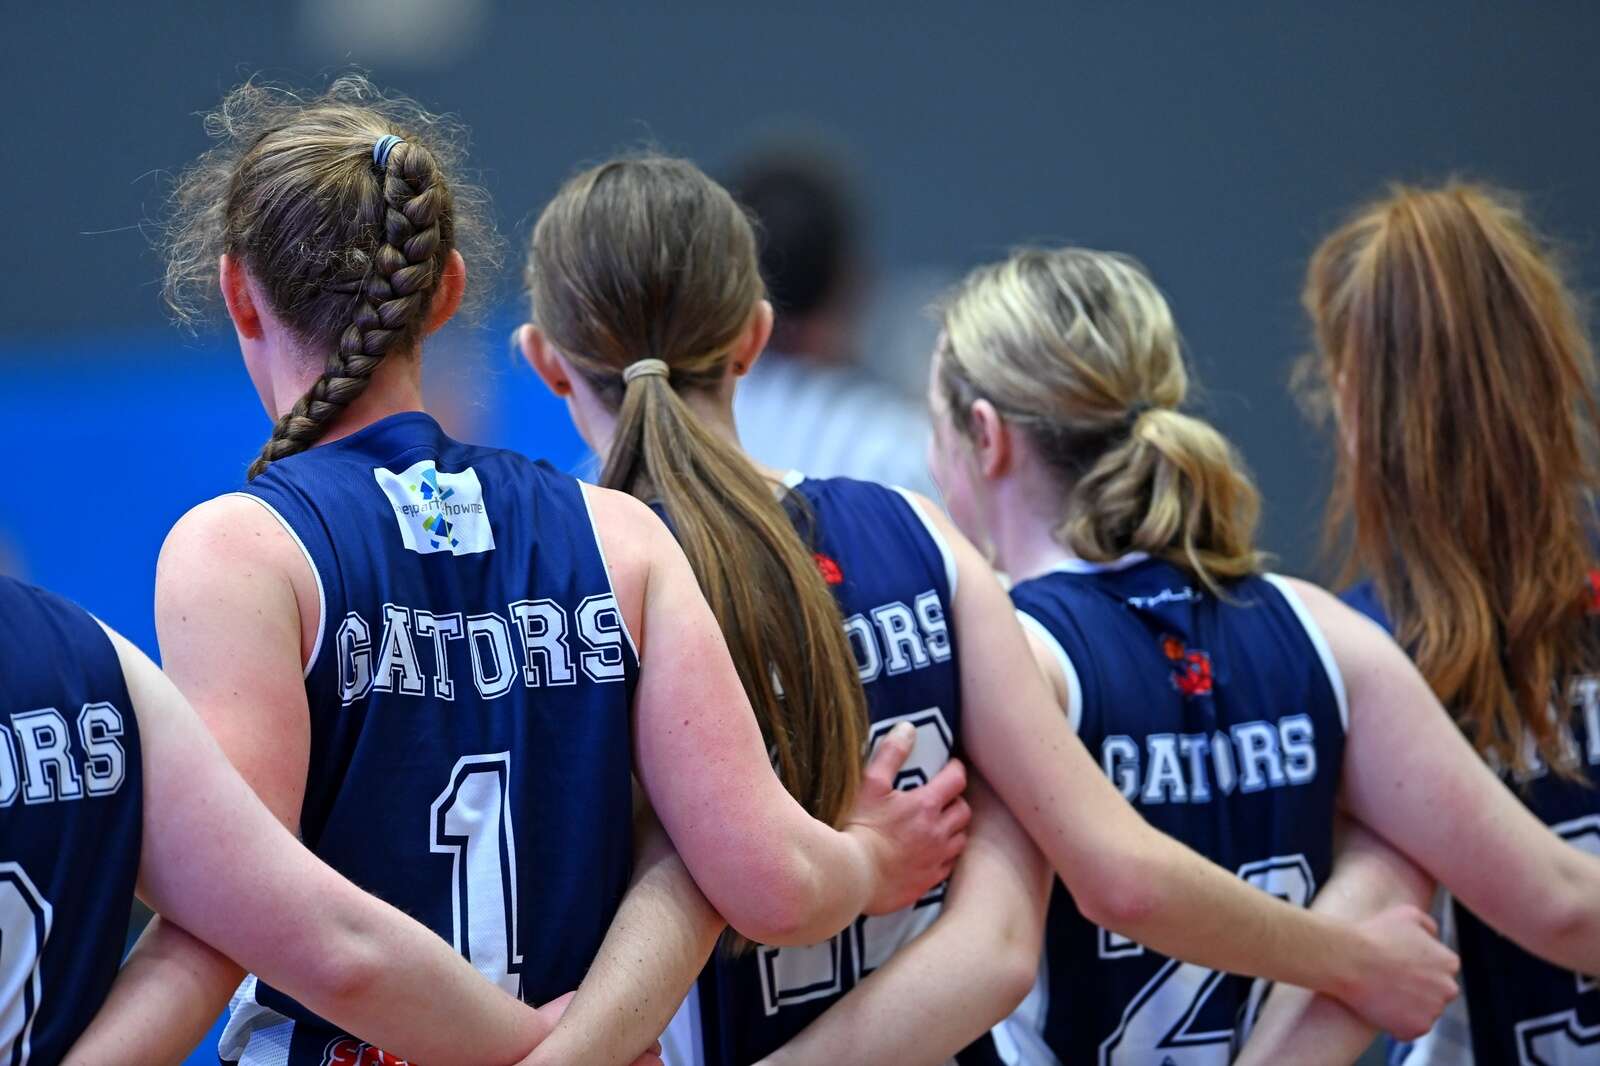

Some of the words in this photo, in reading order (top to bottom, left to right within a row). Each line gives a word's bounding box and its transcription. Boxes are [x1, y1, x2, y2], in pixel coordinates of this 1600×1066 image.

[336, 592, 625, 706] GATORS
[1102, 713, 1317, 804] GATORS
[429, 750, 524, 1001] 1
